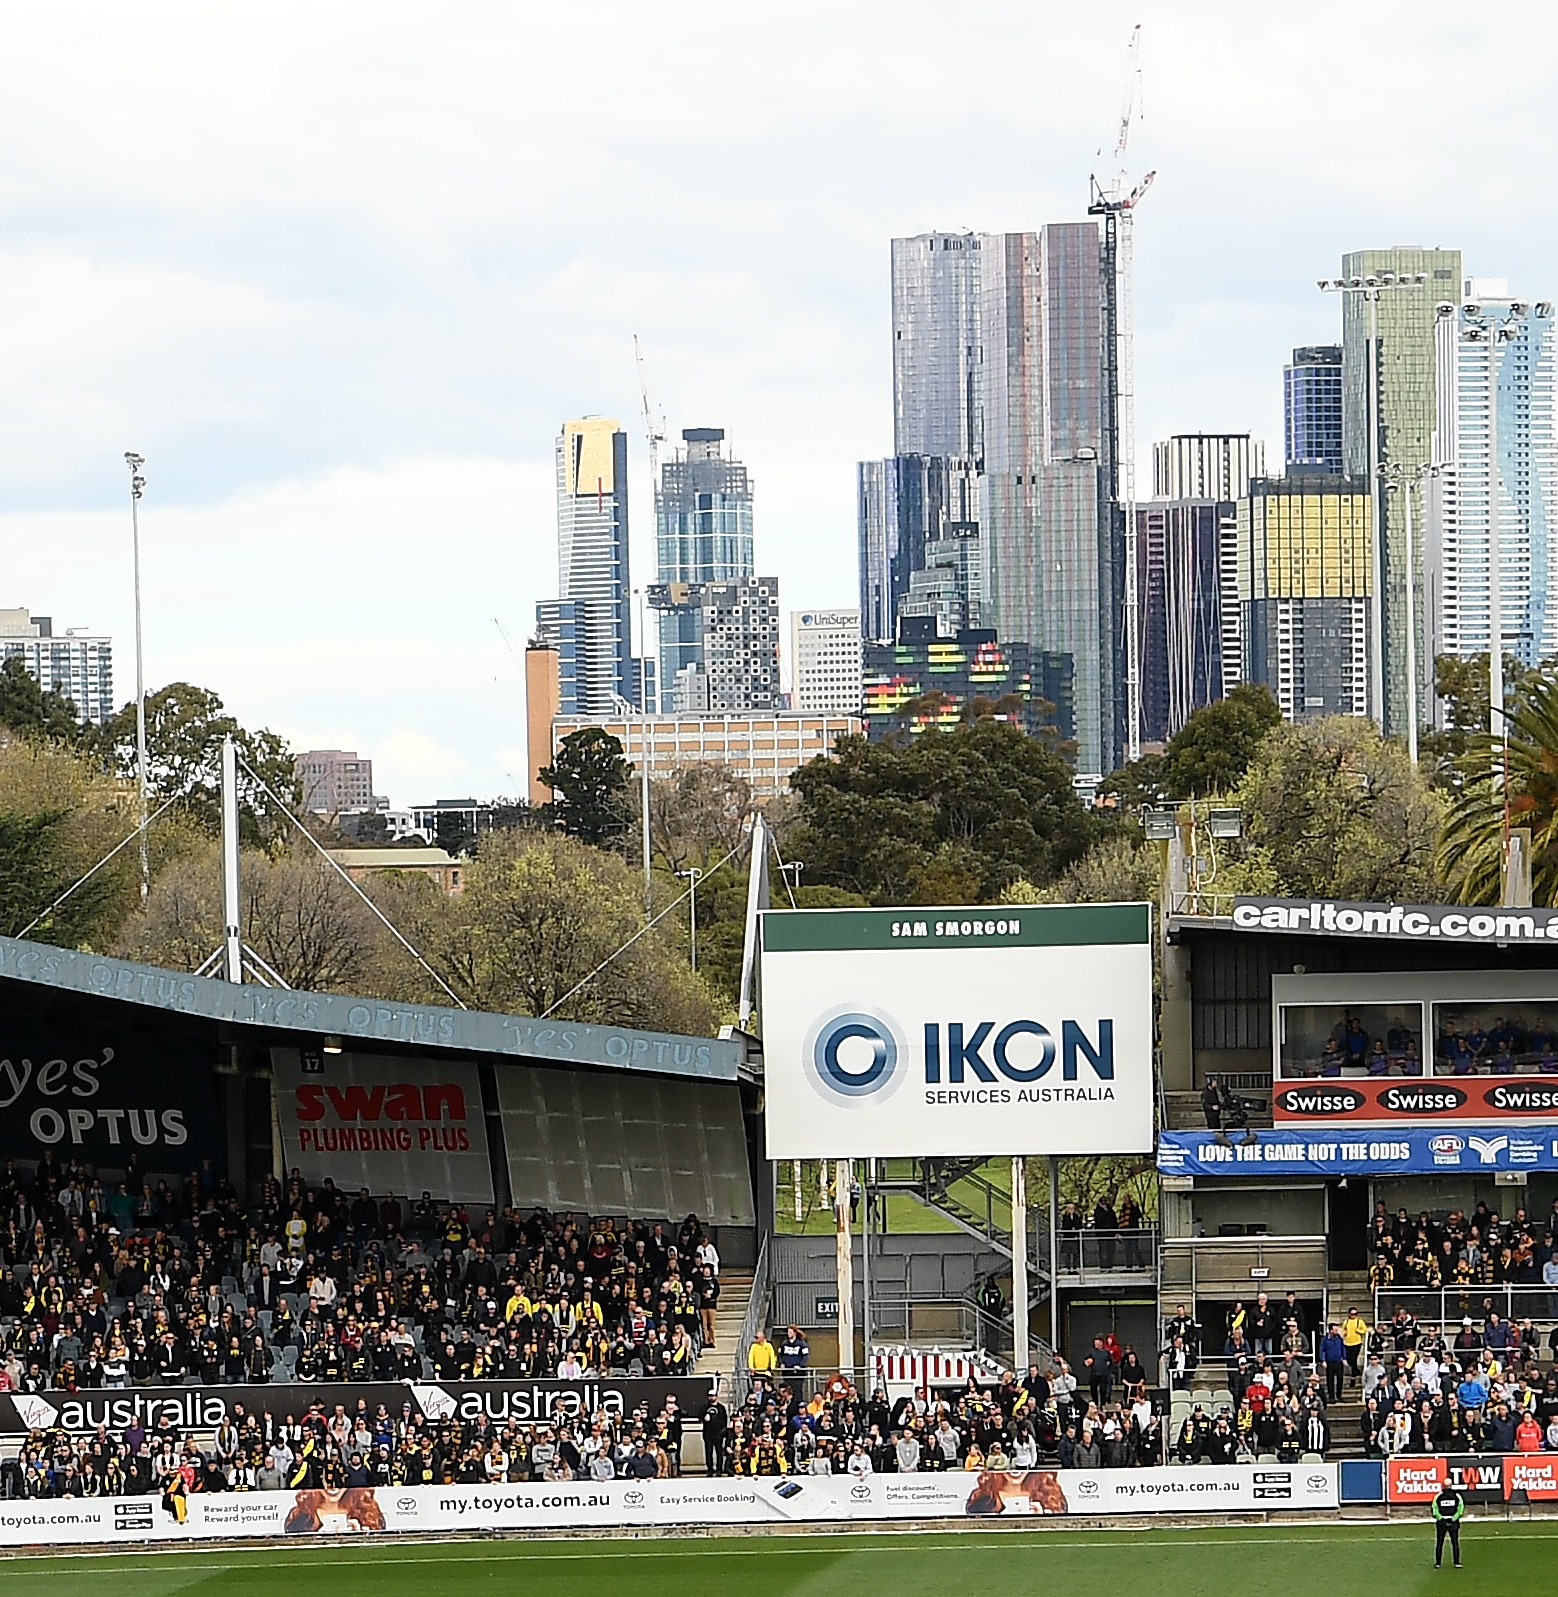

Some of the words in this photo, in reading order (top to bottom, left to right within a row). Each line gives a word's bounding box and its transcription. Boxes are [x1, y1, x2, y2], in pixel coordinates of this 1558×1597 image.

[815, 613, 858, 628] UniSuper
[891, 921, 928, 937] SAM
[935, 919, 1021, 936] SMORGON
[348, 1005, 455, 1039] OPTUS
[605, 1035, 711, 1068] OPTUS
[924, 1019, 1115, 1083] IKON
[295, 1083, 466, 1121] swan
[925, 1089, 1011, 1105] SERVICES
[1017, 1087, 1115, 1103] AUSTRALIA
[1286, 1091, 1355, 1111] Swisse
[1388, 1089, 1457, 1109] Swisse
[28, 1109, 188, 1146] OPTUS
[298, 1128, 412, 1152] PLUMBING
[419, 1127, 470, 1151] PLUS
[1432, 1139, 1462, 1150] AFL
[61, 1392, 225, 1428] australia
[1115, 1481, 1240, 1495] my.toyota.com.au
[204, 1505, 239, 1513] Reward
[241, 1504, 263, 1513] your
[440, 1493, 611, 1513] my.toyota.com.au
[660, 1496, 680, 1505] Easy
[682, 1494, 714, 1504] Service
[717, 1493, 755, 1504] Booking
[204, 1515, 239, 1523] Reward
[241, 1513, 279, 1523] yourself
